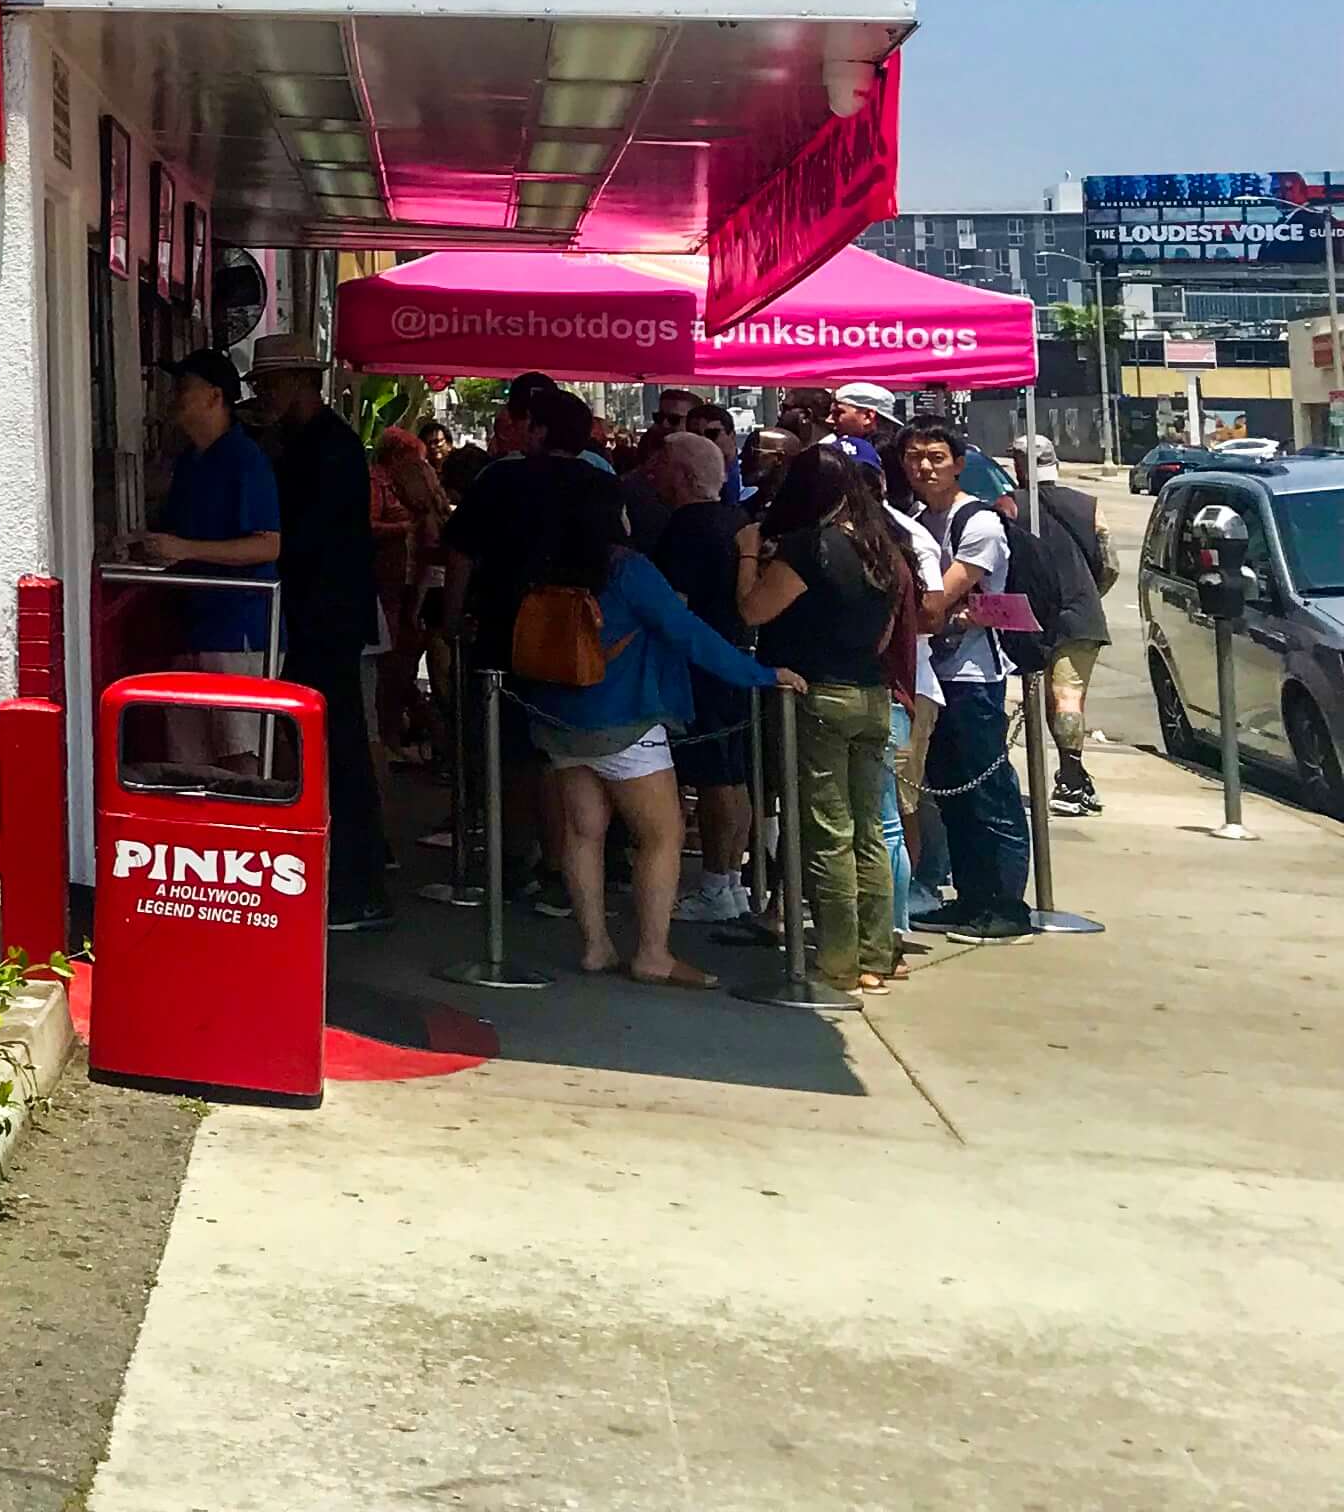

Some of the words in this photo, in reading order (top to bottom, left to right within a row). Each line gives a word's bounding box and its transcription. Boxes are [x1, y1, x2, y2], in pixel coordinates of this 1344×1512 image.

[1094, 229, 1116, 240] THE
[1118, 224, 1226, 242] LOUDEST
[1230, 223, 1304, 241] VOICE
[1309, 228, 1344, 238] SUD
[391, 305, 679, 348] @pinkshotdogs
[112, 839, 307, 896] PINK'S
[156, 884, 167, 897] A
[169, 885, 261, 908] HOLLYWOOD
[137, 899, 195, 919] LEGEND
[198, 906, 242, 924] SINCE
[246, 912, 279, 929] 1939
